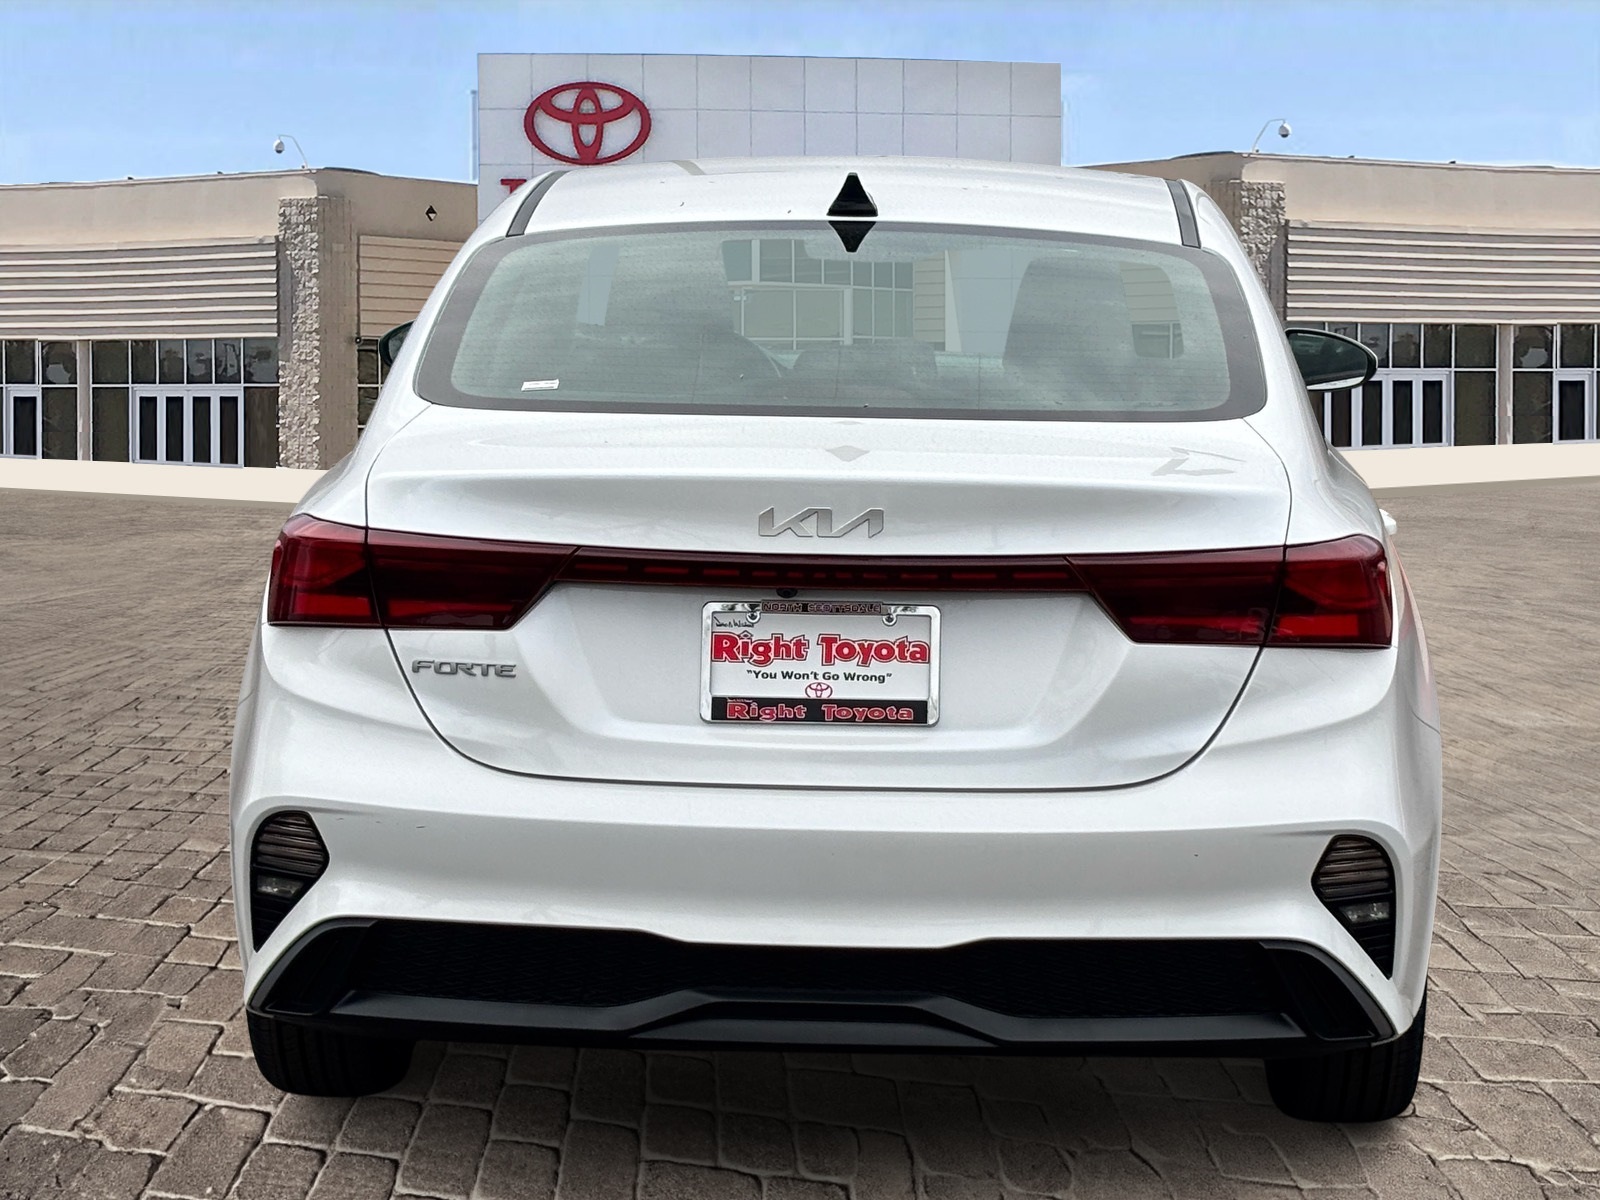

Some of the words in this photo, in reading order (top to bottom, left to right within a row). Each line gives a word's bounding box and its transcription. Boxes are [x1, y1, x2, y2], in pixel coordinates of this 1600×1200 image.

[758, 505, 884, 538] KIA
[762, 602, 801, 612] NORTH
[808, 603, 881, 614] SCOTTSDALE
[711, 630, 810, 667] Right
[817, 633, 930, 667] Toyota
[411, 659, 517, 678] FORTE
[822, 671, 840, 682] Go
[726, 702, 807, 722] Right
[821, 704, 914, 722] Toyota
